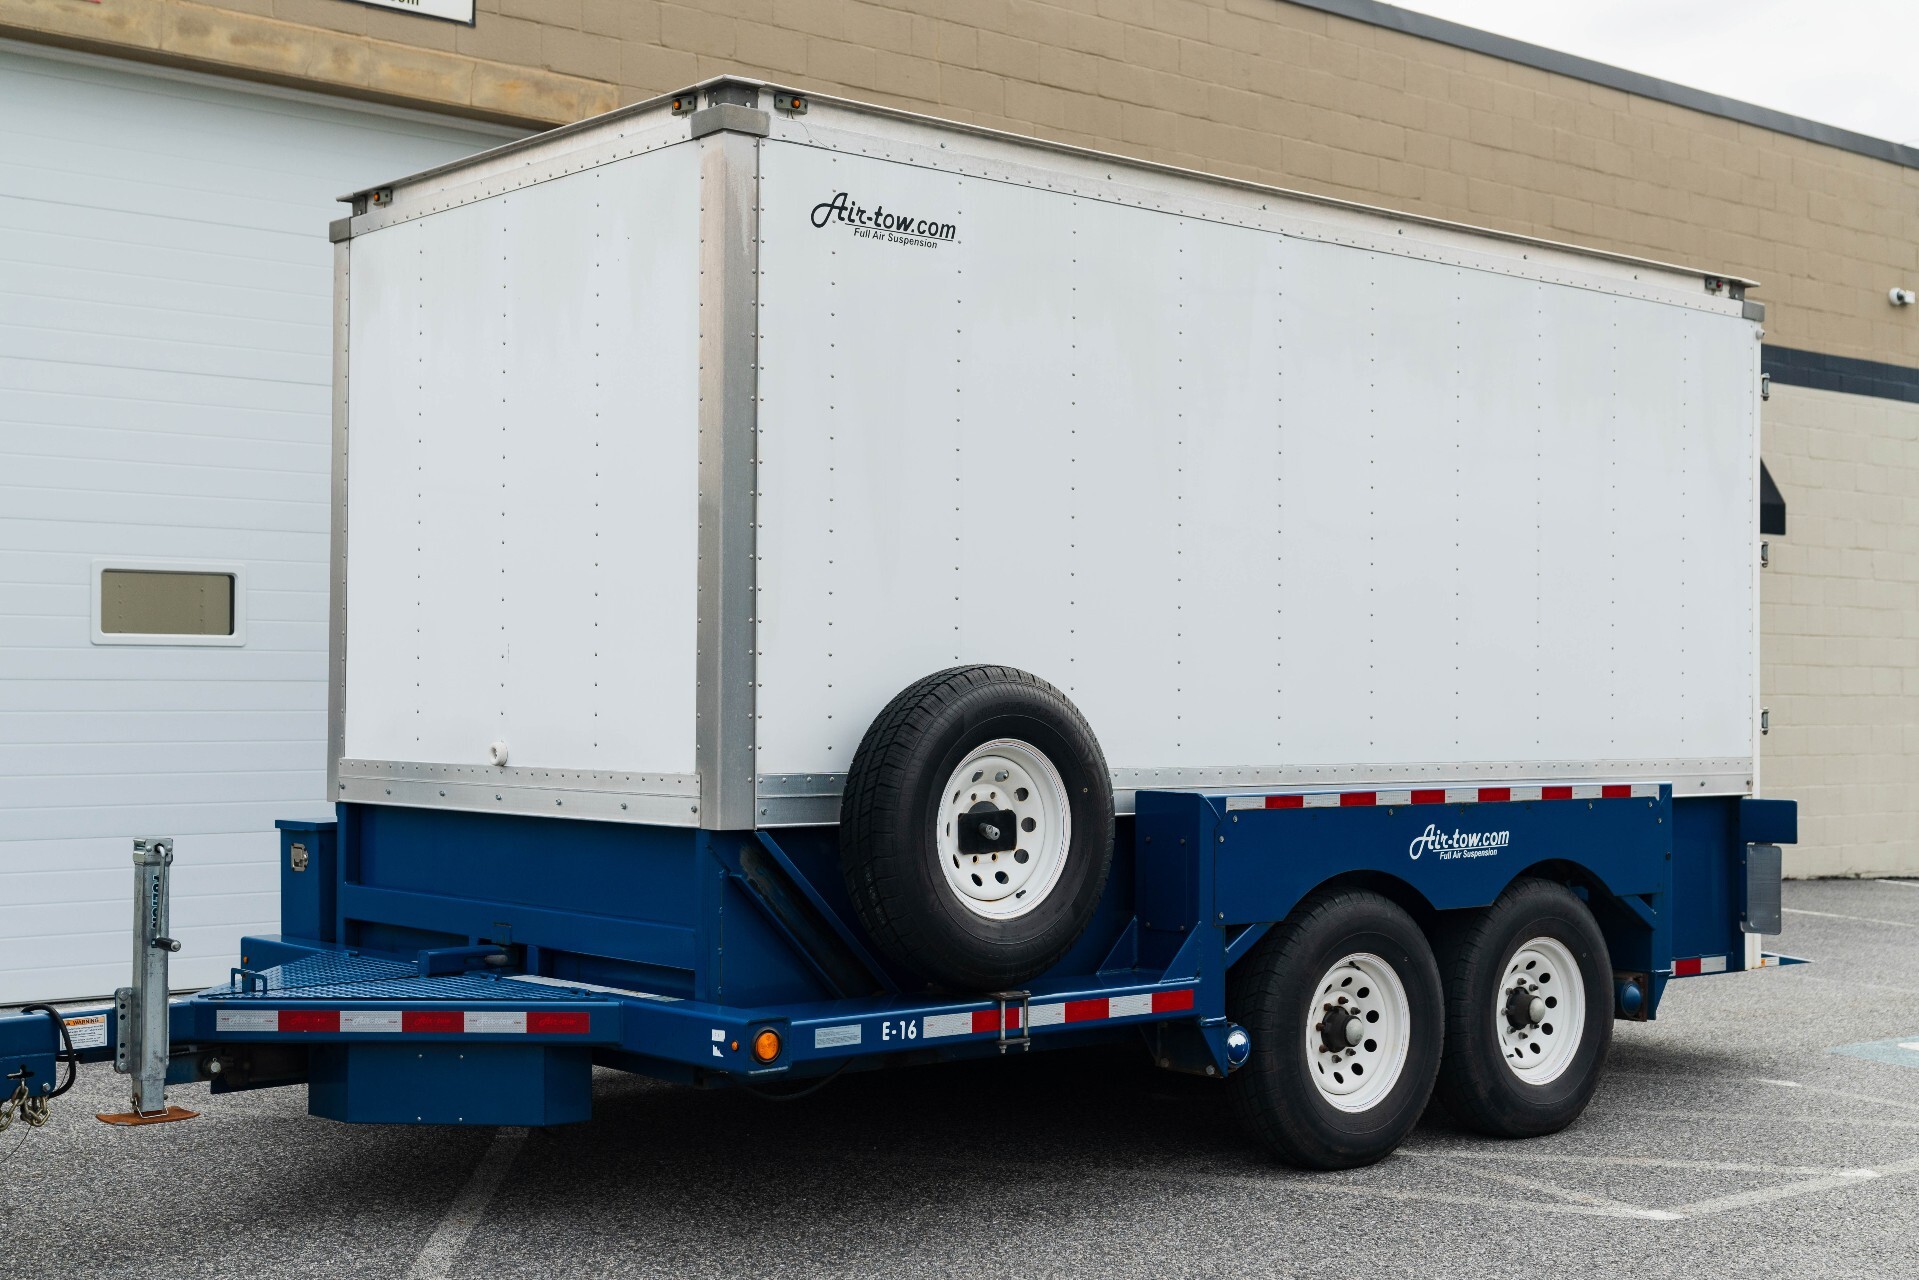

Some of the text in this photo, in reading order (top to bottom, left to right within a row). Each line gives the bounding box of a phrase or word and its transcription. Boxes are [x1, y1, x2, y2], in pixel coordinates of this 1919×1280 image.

[811, 192, 956, 239] Air-tow.com
[853, 228, 938, 249] Full Air Suspension
[1409, 823, 1509, 860] Air-tow.com
[1440, 848, 1497, 860] Full Air Suspension
[882, 1020, 917, 1040] E-16
